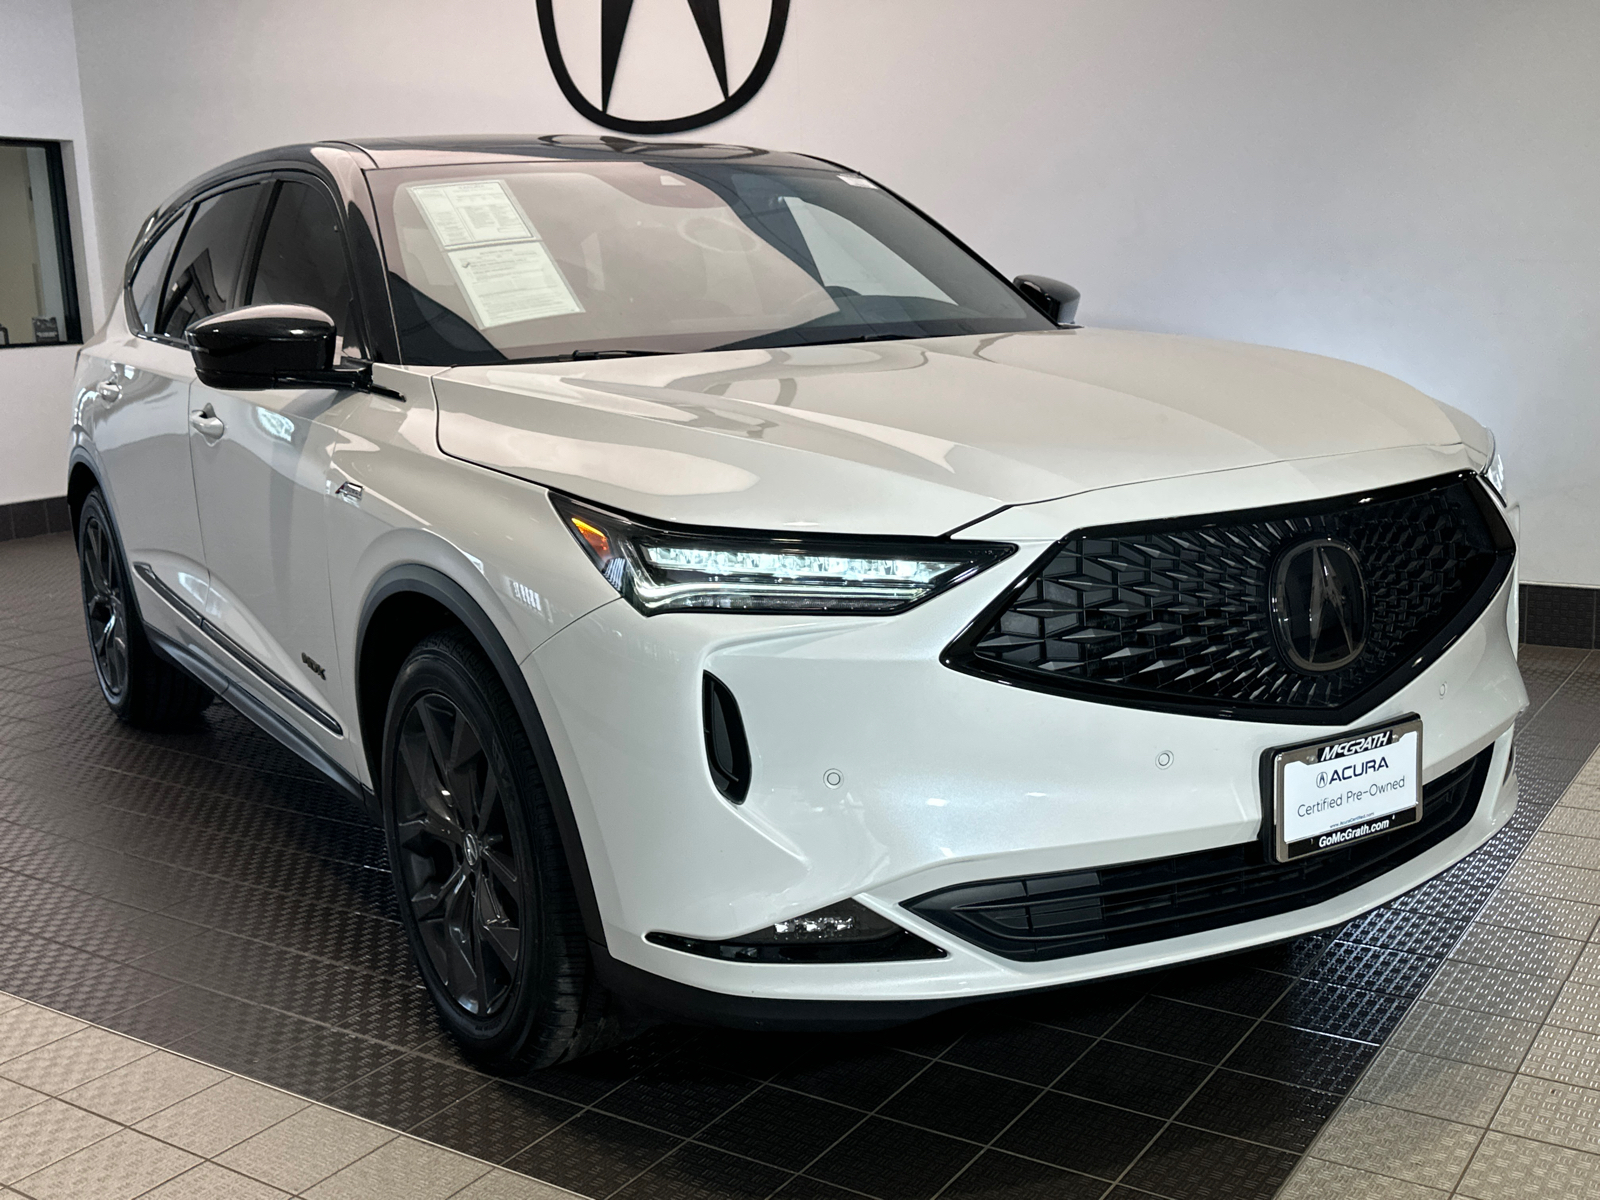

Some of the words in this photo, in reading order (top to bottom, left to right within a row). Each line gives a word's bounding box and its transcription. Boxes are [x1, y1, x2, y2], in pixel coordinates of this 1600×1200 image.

[1329, 756, 1389, 785] ACURA
[1297, 794, 1343, 817] Certified
[1346, 775, 1405, 804] Pre-Owned
[1318, 819, 1390, 848] GoMcGrath.com
